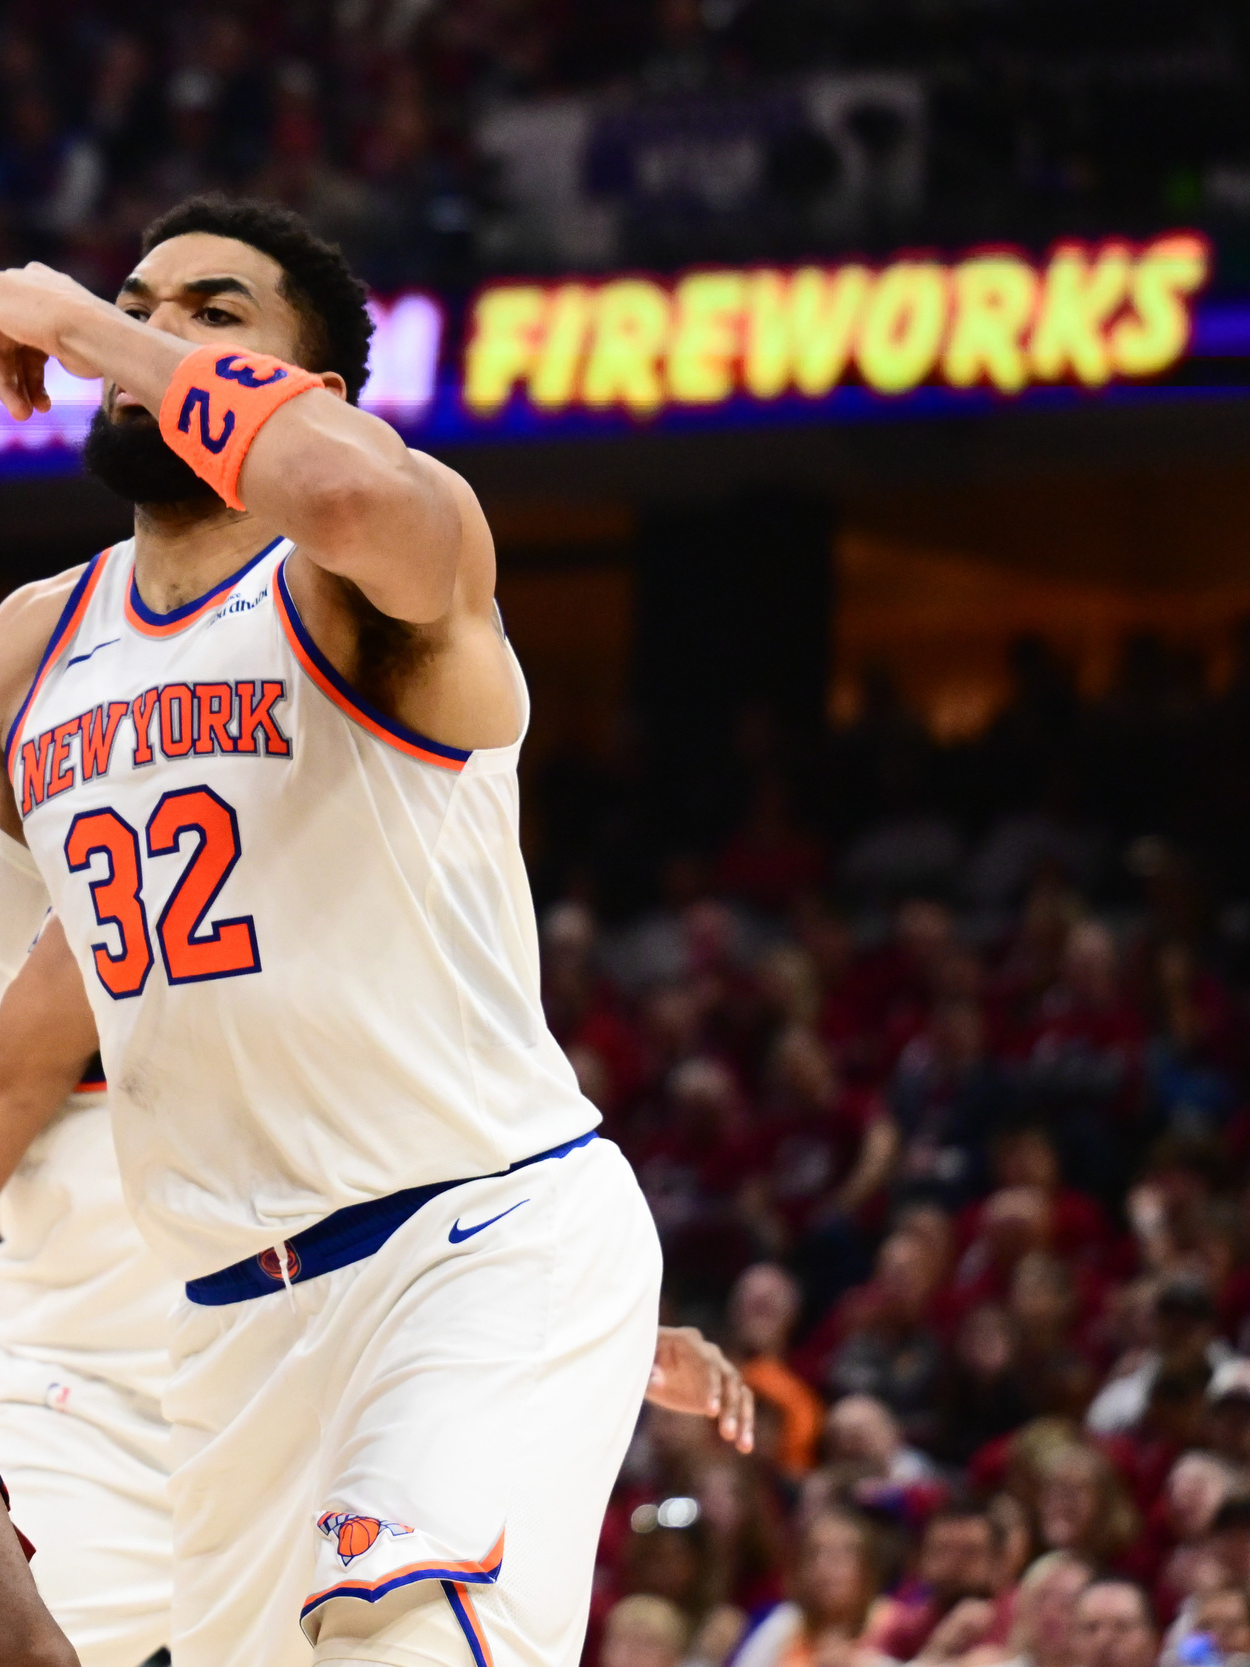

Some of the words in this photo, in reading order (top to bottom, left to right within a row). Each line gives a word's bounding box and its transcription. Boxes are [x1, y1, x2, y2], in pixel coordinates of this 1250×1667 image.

[463, 232, 1207, 416] FIREWORKS
[20, 700, 130, 818] NEW
[131, 678, 294, 771] YORK
[63, 783, 262, 1001] 32
